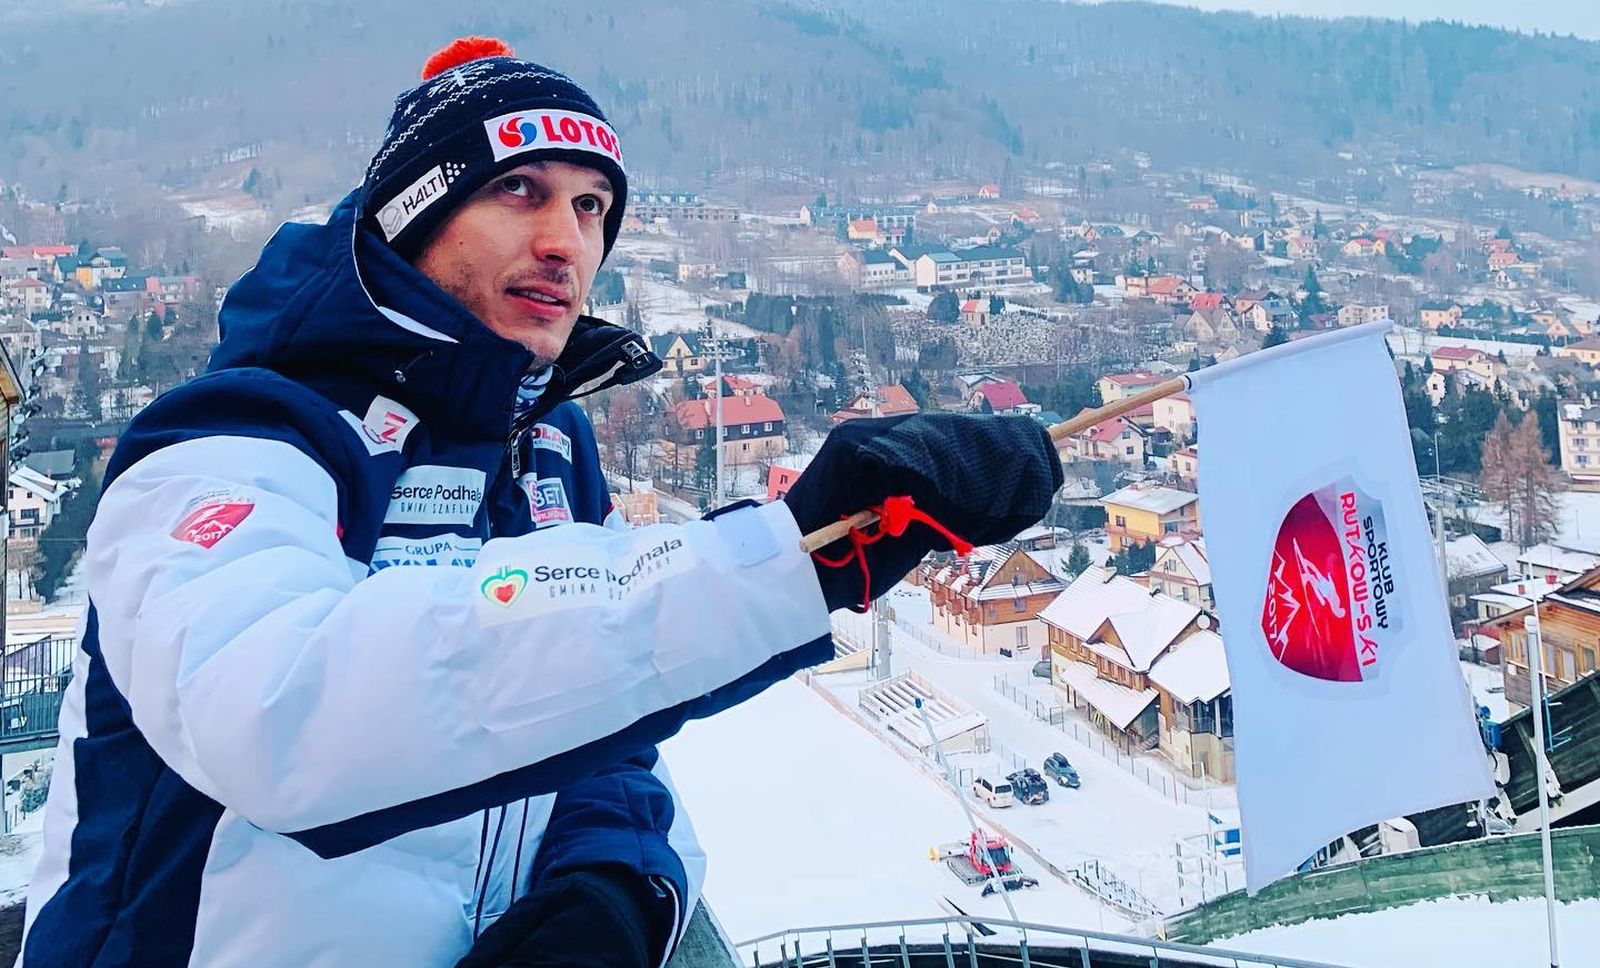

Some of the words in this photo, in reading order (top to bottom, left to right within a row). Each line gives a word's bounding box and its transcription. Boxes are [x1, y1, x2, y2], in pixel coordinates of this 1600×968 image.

[541, 115, 622, 161] LOTOS
[402, 173, 445, 216] HALTI
[391, 485, 433, 500] Serce
[193, 530, 223, 543] 2017
[405, 541, 452, 555] GRUPA
[534, 565, 600, 582] Serce
[1339, 491, 1378, 667] RUTKOW-SKI
[1362, 515, 1389, 629] SPORTOWY
[1377, 541, 1395, 595] KLUB
[549, 582, 597, 598] GMINA
[1267, 579, 1278, 639] 2017
